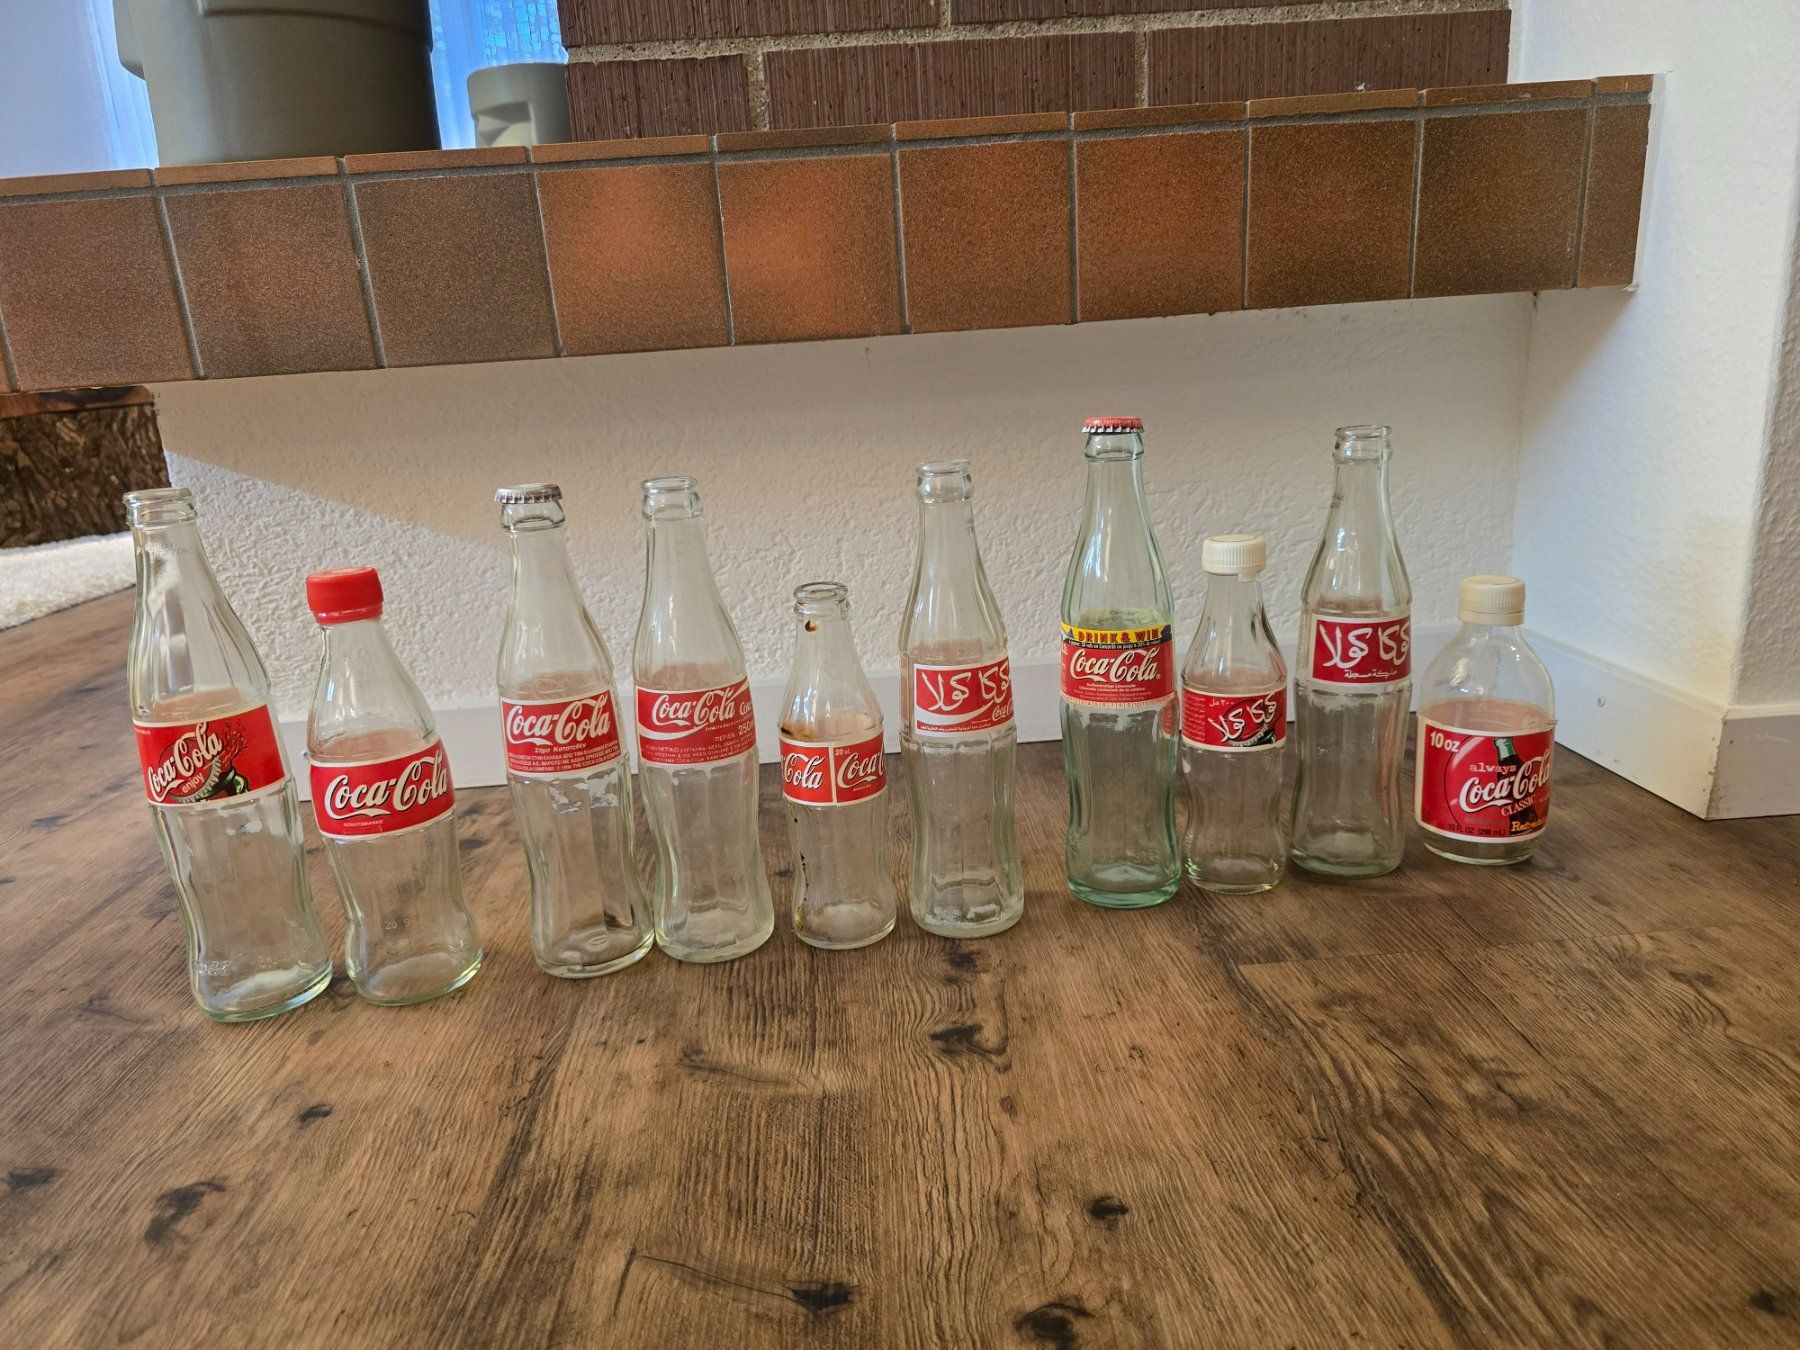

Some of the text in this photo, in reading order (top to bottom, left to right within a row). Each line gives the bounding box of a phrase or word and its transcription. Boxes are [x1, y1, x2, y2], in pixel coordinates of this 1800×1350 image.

[1078, 630, 1118, 643] DRINK
[1121, 631, 1130, 642] &
[1135, 628, 1159, 641] WIN
[1319, 620, 1410, 669] كوكا كولا
[1070, 647, 1160, 683] Coca-Cola
[922, 661, 1010, 711] كوكا كولا
[506, 692, 611, 746] Coca-Cola
[652, 687, 738, 728] Coca-Cola
[1208, 708, 1246, 743] كولا
[1246, 693, 1277, 723] كوكا
[1430, 731, 1444, 748] 10
[148, 721, 223, 802] Coca-Cola
[1470, 762, 1517, 774] always
[181, 772, 205, 794] enjoy
[325, 749, 448, 821] Coca-Cola
[1459, 747, 1550, 813] Coca-Cola
[1501, 796, 1536, 817] CLASSIC
